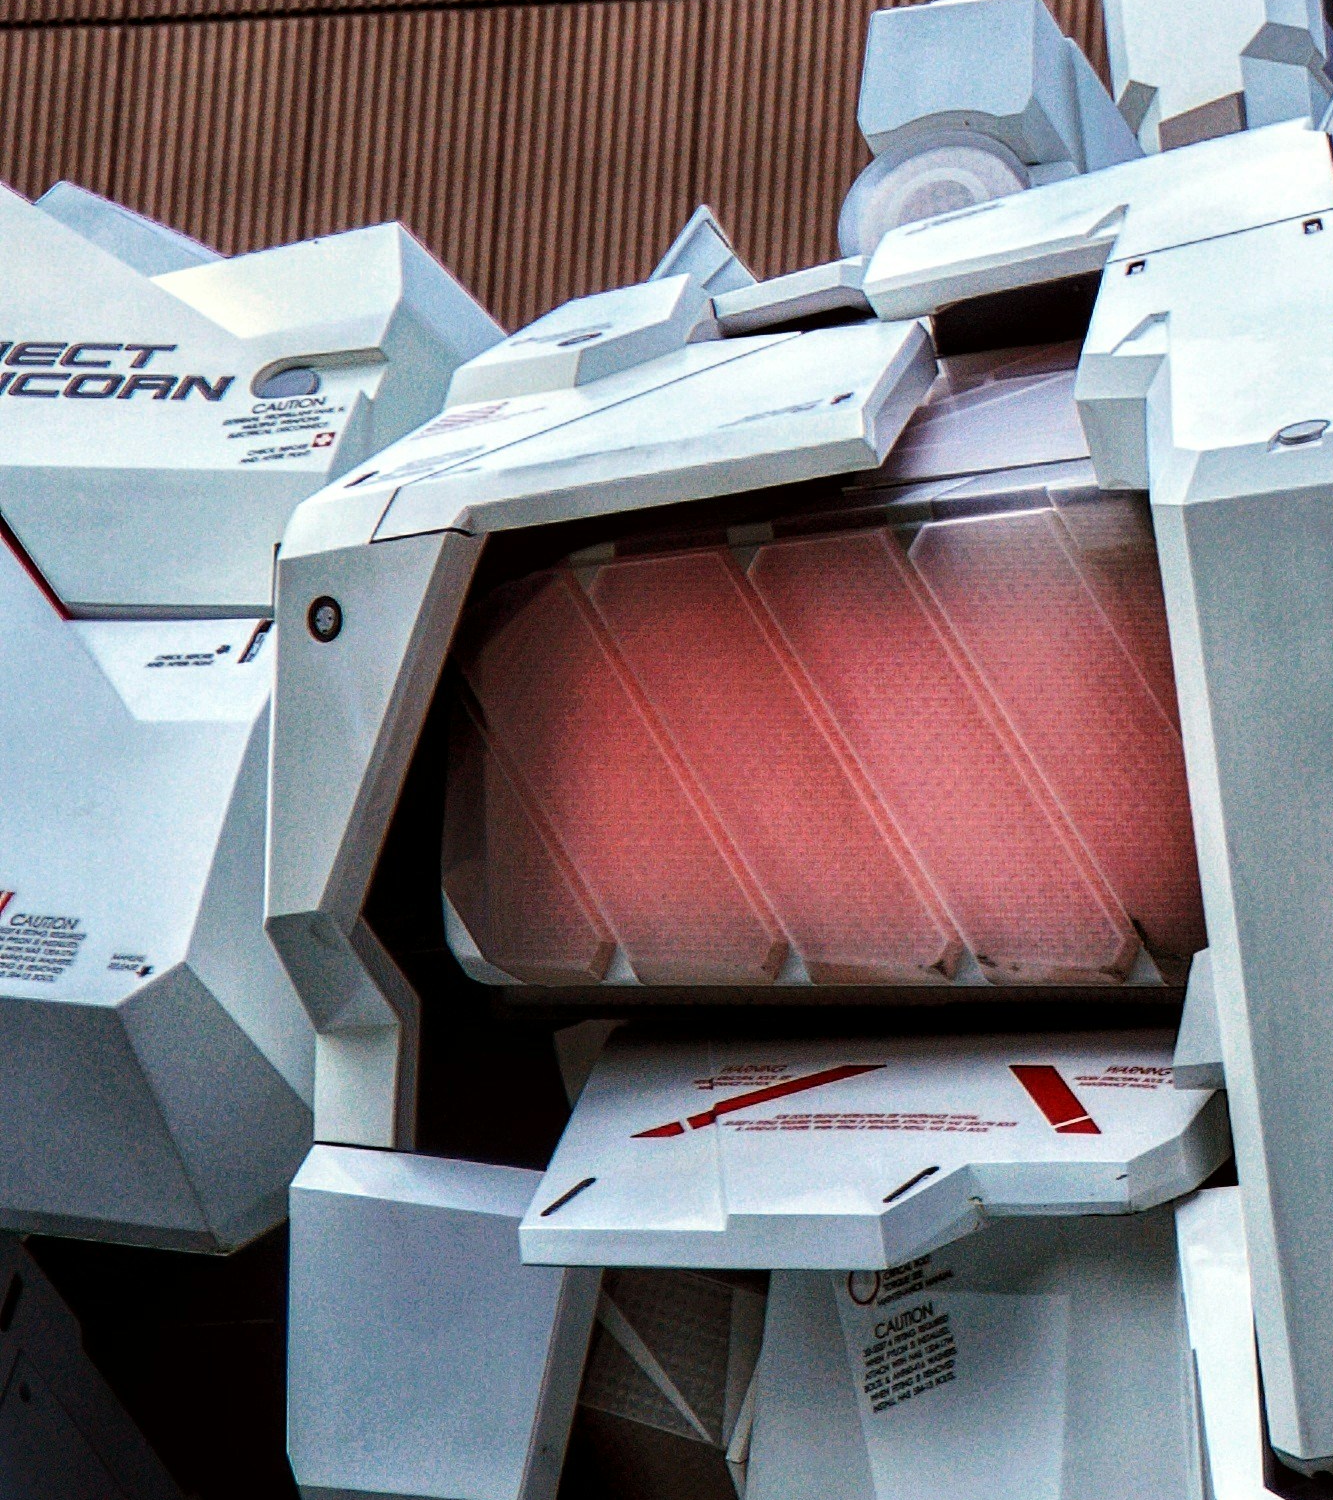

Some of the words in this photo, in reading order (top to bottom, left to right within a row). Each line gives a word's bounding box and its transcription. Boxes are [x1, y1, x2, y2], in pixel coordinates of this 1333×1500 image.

[252, 396, 328, 414] CAUTION
[10, 913, 80, 930] CAUTION
[874, 1302, 933, 1339] CAUTION
